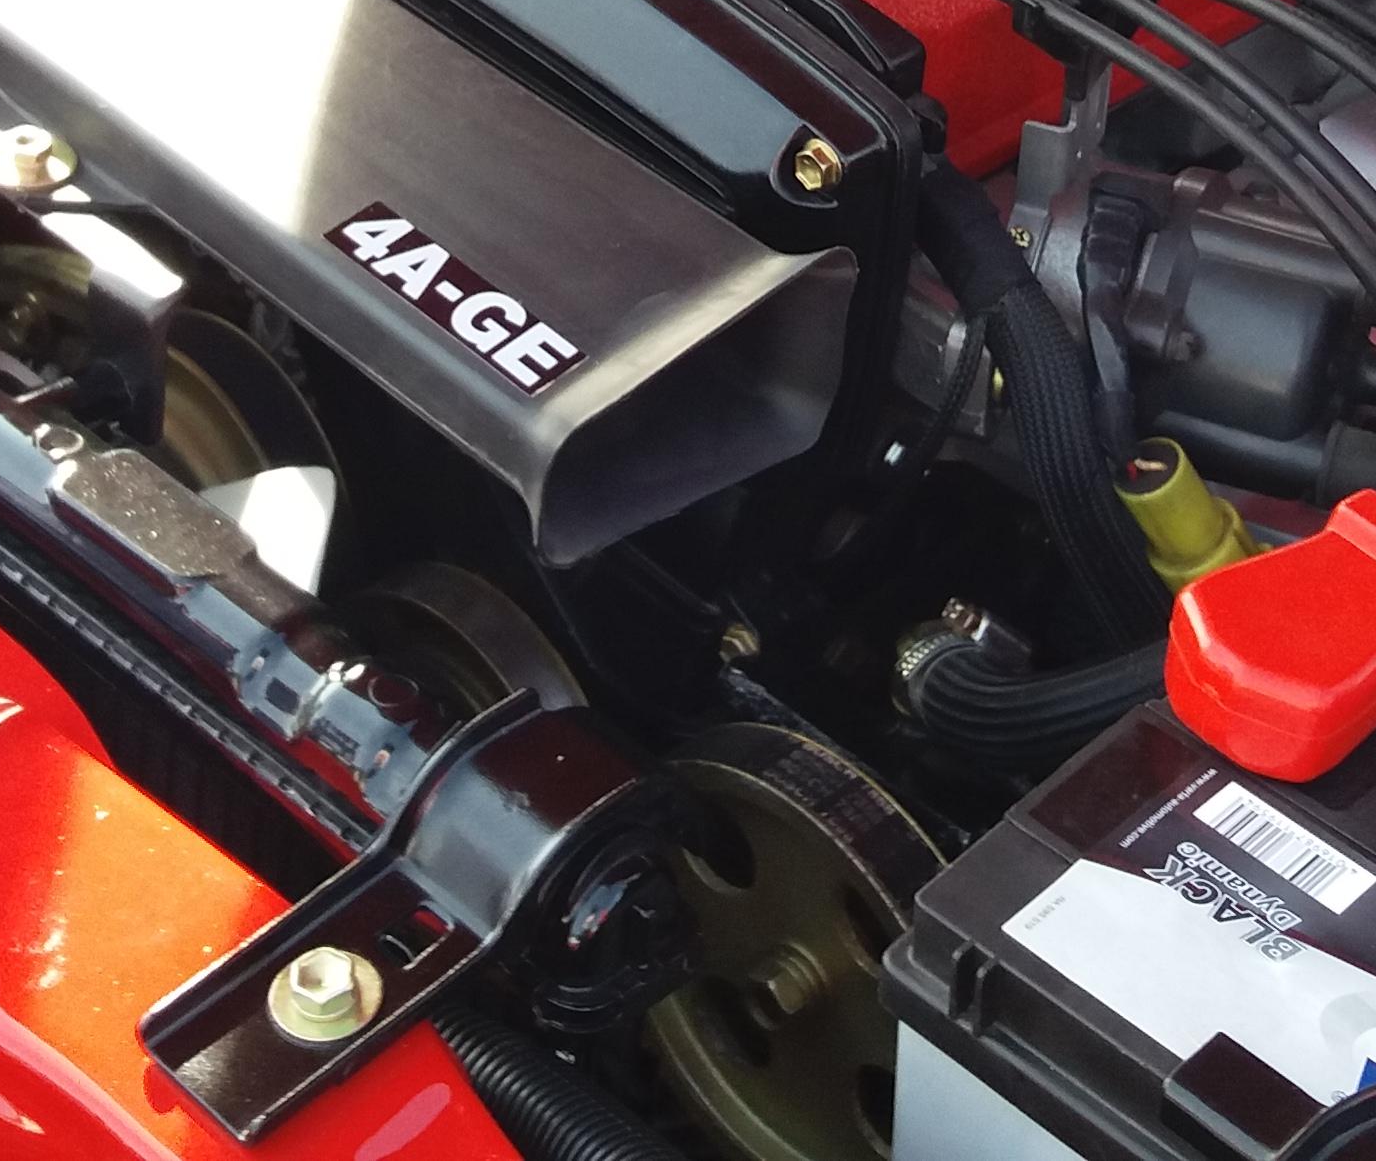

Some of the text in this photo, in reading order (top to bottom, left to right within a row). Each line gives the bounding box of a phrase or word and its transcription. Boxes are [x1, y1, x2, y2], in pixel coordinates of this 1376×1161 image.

[341, 218, 580, 388] 4A-GE
[1119, 767, 1219, 849] www.varta-automotive.com
[1142, 853, 1309, 963] BLACK
[1175, 840, 1304, 932] Dynamic
